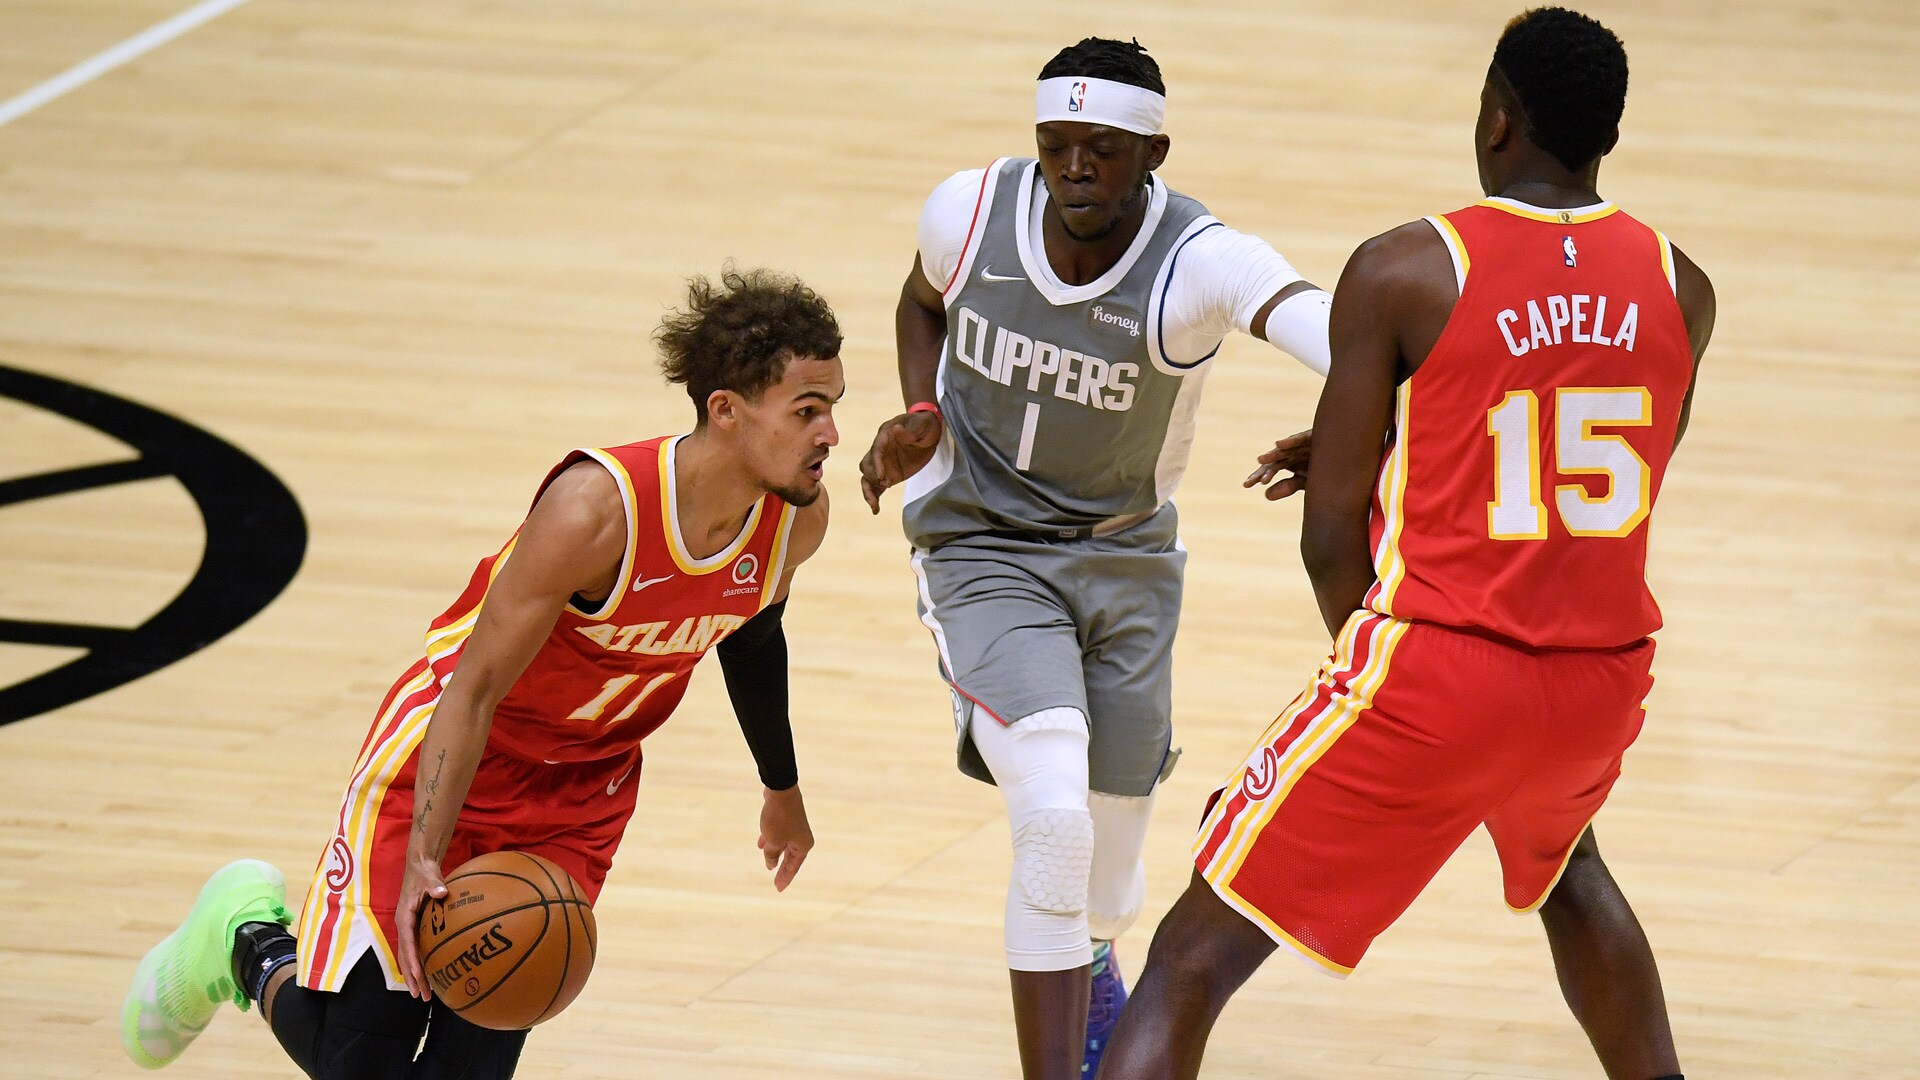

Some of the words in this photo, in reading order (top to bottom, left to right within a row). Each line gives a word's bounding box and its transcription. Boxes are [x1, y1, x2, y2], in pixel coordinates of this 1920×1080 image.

[1092, 306, 1139, 336] honey
[1496, 294, 1638, 357] CAPELA
[956, 306, 1139, 411] CLIPPERS
[1016, 402, 1040, 471] 1
[1487, 386, 1652, 540] 15
[722, 586, 759, 598] sharecare
[574, 614, 748, 656] ATLANT
[566, 672, 677, 727] 11
[431, 922, 513, 991] SPALDIN
